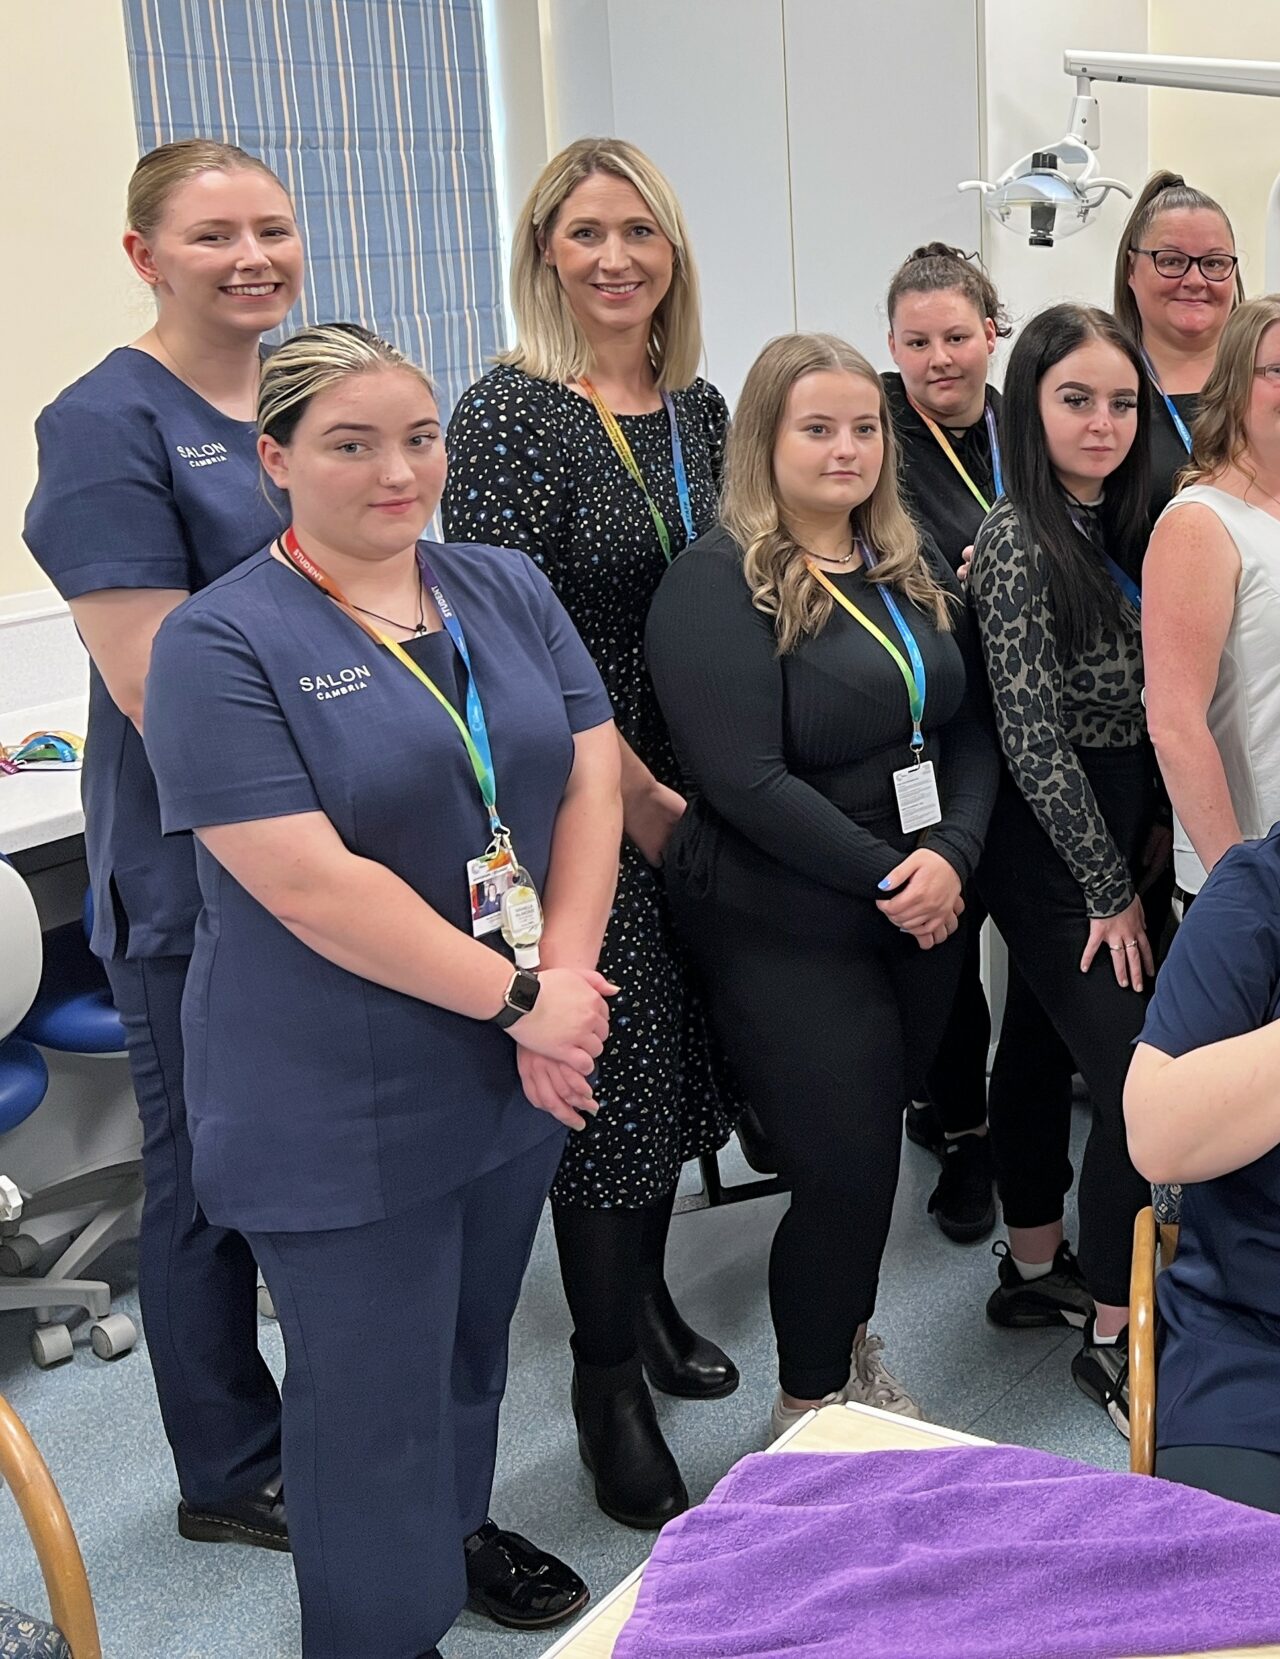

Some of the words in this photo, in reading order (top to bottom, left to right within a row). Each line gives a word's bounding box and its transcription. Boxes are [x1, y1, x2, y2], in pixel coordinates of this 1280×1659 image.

[176, 442, 227, 458] SALON
[189, 455, 227, 467] CAMBRIA
[293, 549, 324, 582] STUDENT
[431, 585, 453, 618] STUDENT
[299, 665, 371, 691] SALON
[316, 682, 367, 700] CAMBRIA
